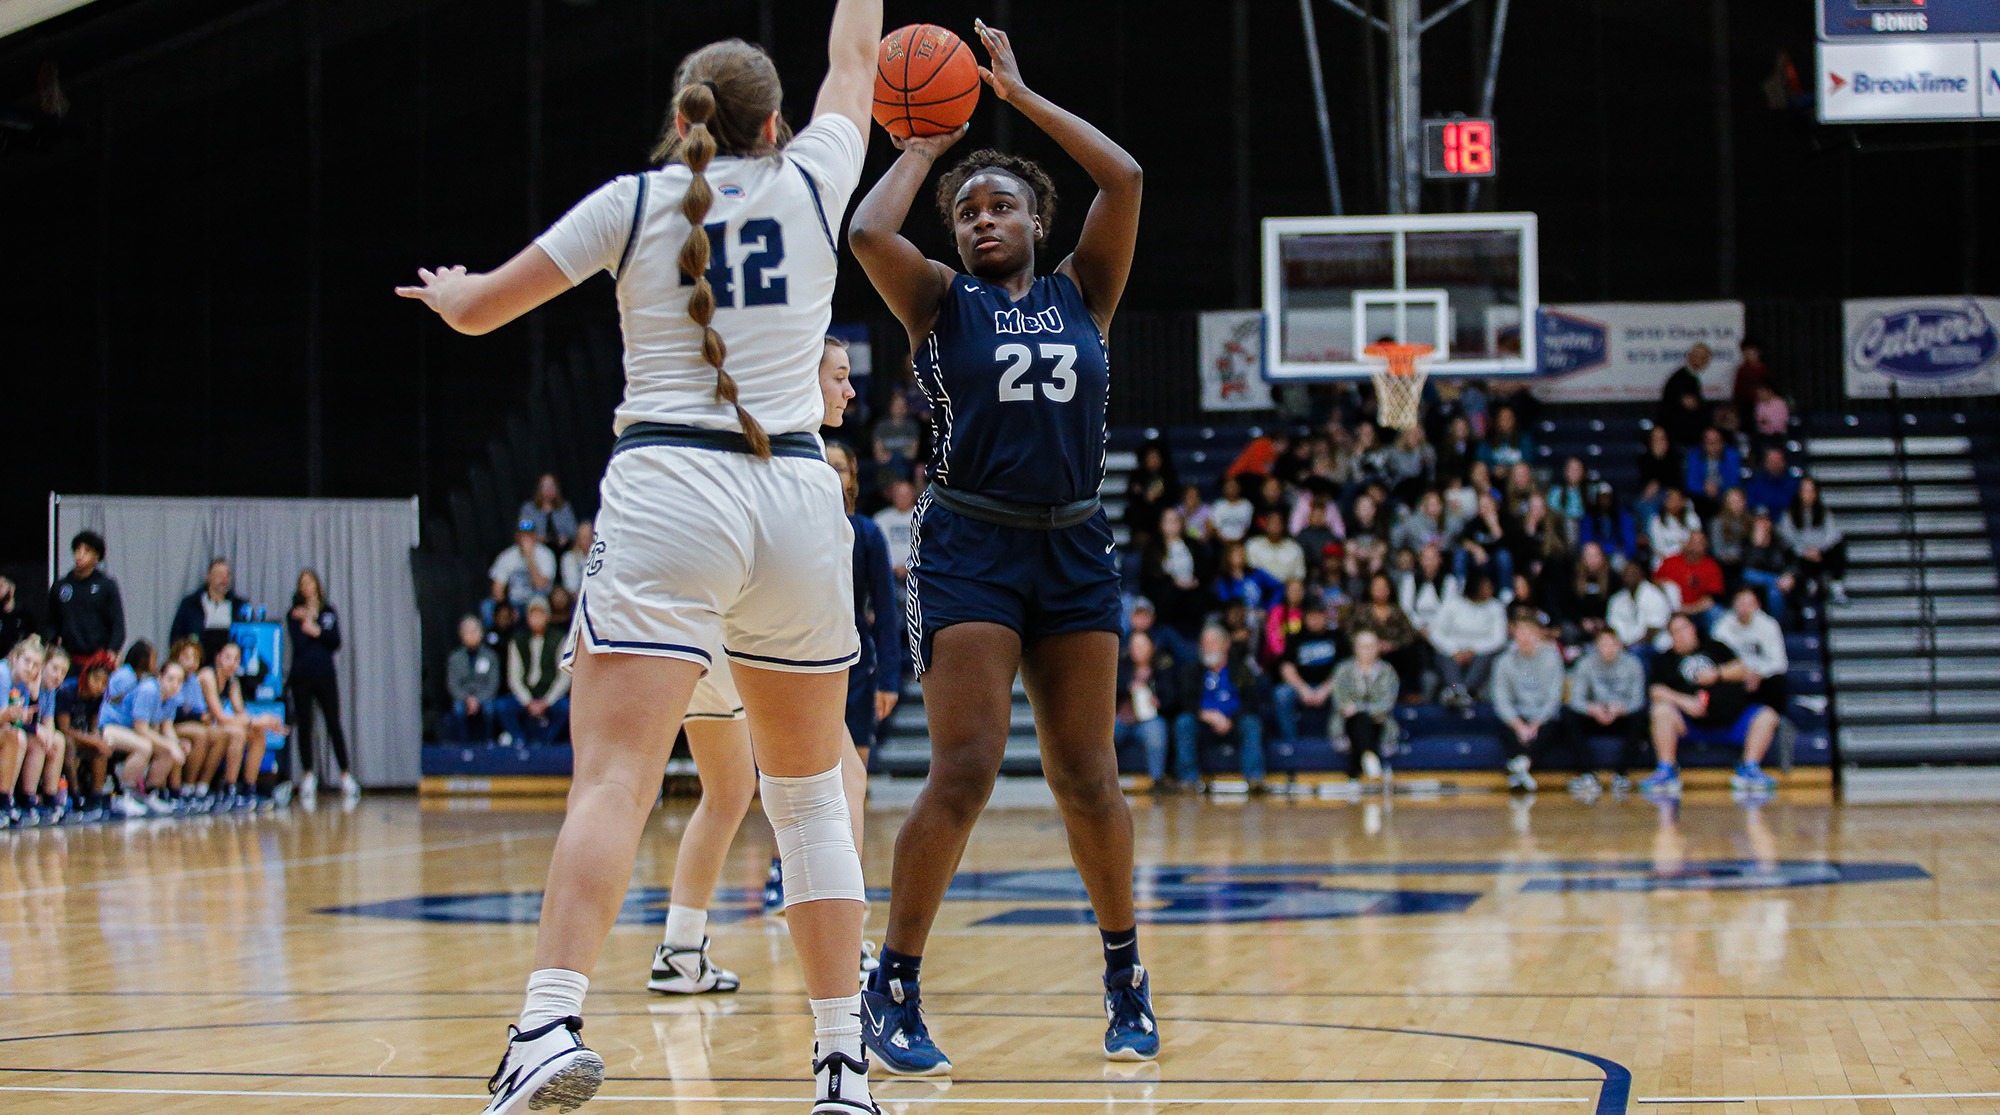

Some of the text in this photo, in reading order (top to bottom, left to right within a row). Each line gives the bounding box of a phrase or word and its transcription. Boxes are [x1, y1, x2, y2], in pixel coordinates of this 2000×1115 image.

[1872, 12, 1928, 31] BONUS
[680, 216, 789, 308] 42
[995, 343, 1078, 403] 23
